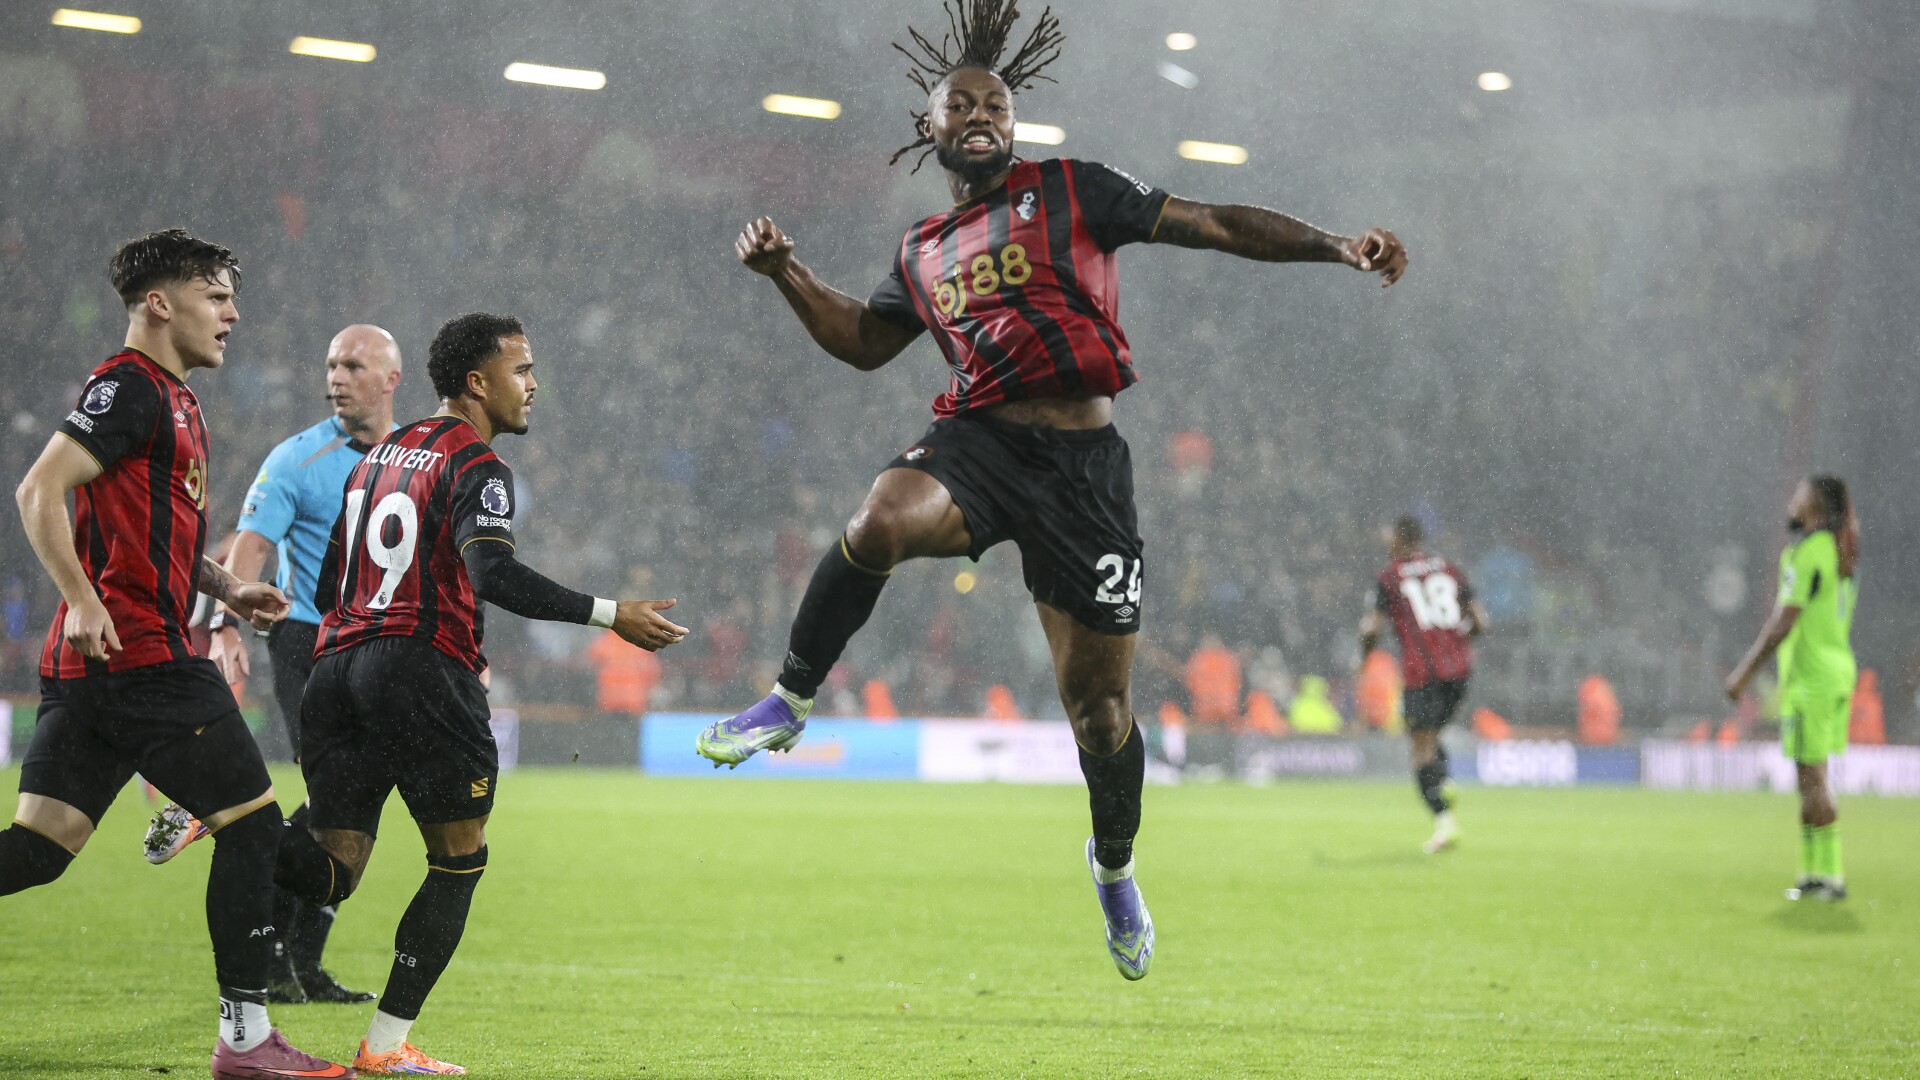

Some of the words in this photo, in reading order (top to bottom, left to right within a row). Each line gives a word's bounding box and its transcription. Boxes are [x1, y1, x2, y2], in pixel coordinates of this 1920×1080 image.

[931, 243, 1033, 319] bj88
[185, 458, 208, 510] bj
[341, 488, 418, 610] 19
[1095, 553, 1142, 608] 24
[1400, 572, 1462, 631] 18
